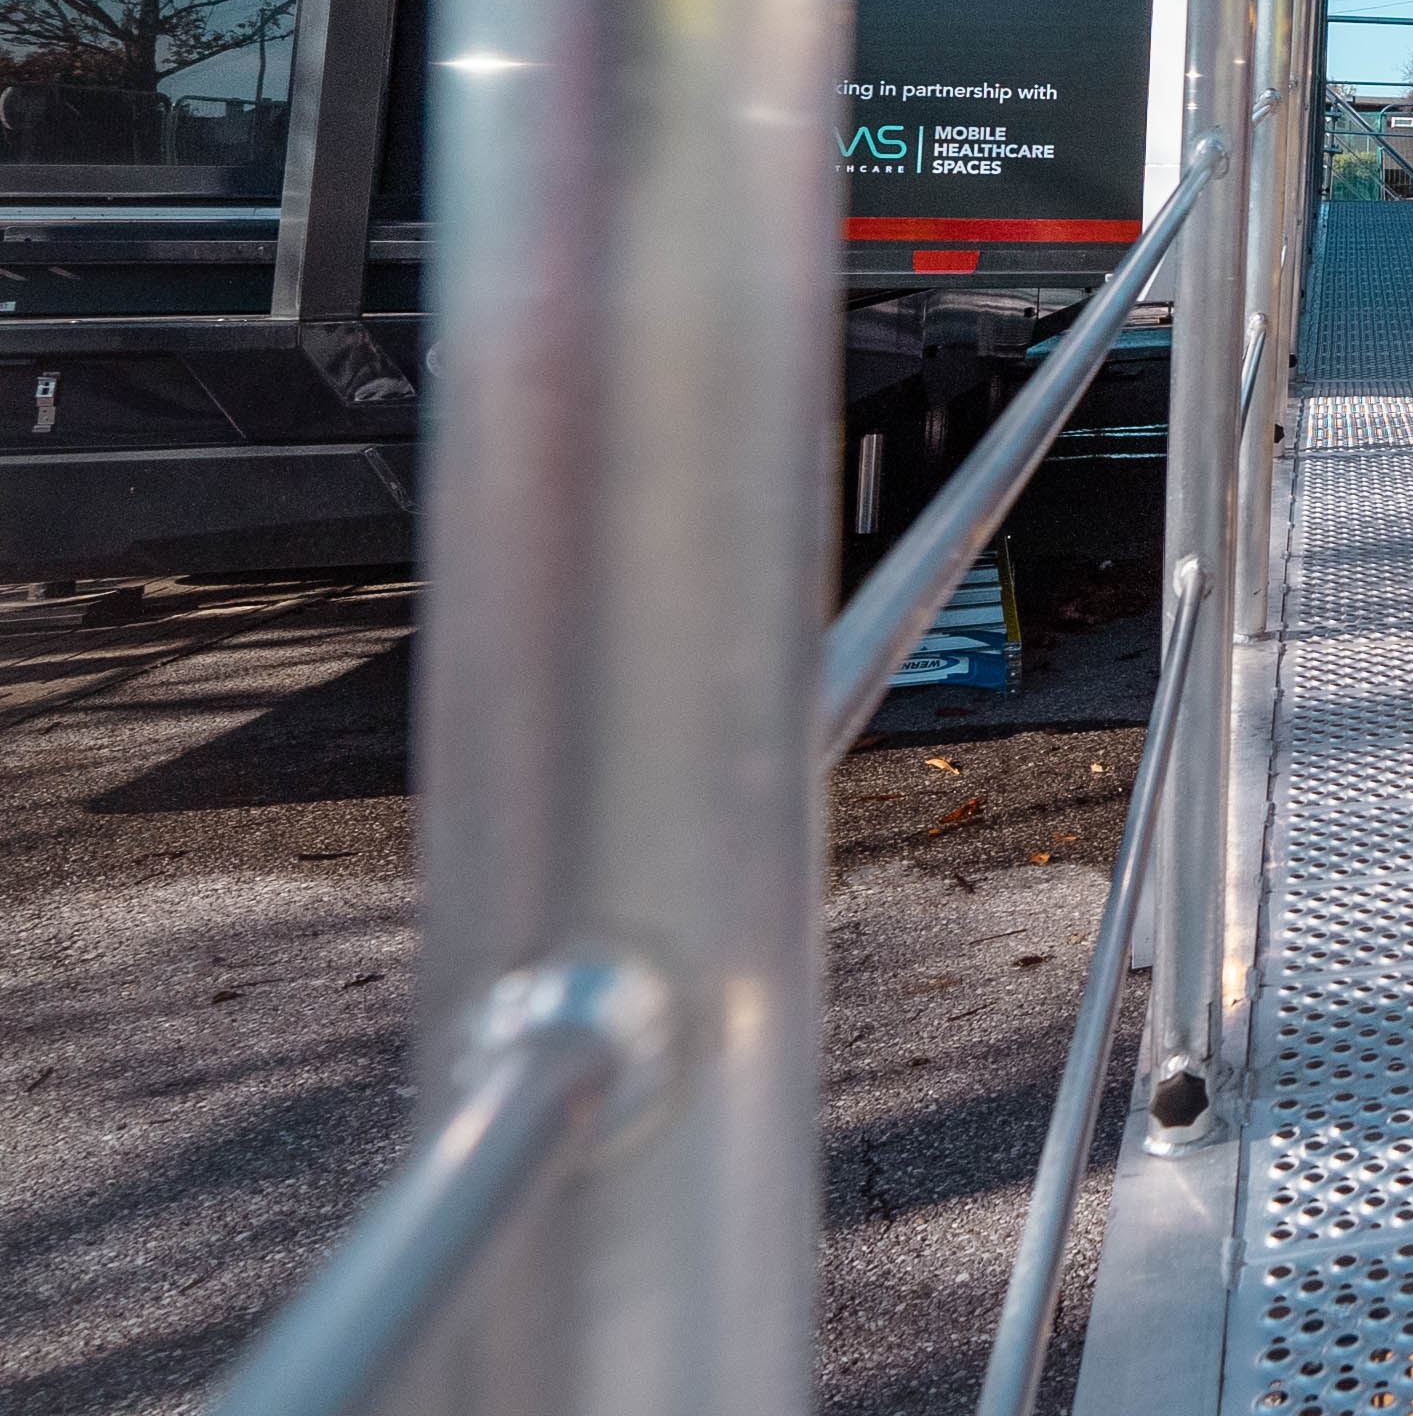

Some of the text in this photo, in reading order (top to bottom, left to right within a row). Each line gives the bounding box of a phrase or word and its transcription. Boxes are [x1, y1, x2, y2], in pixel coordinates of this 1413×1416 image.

[880, 80, 896, 96] in
[902, 82, 1012, 103] partnership
[1017, 84, 1058, 100] with
[934, 125, 1007, 141] MOBILE
[933, 143, 1056, 159] HEALTHCARE
[931, 160, 1002, 175] SPACES
